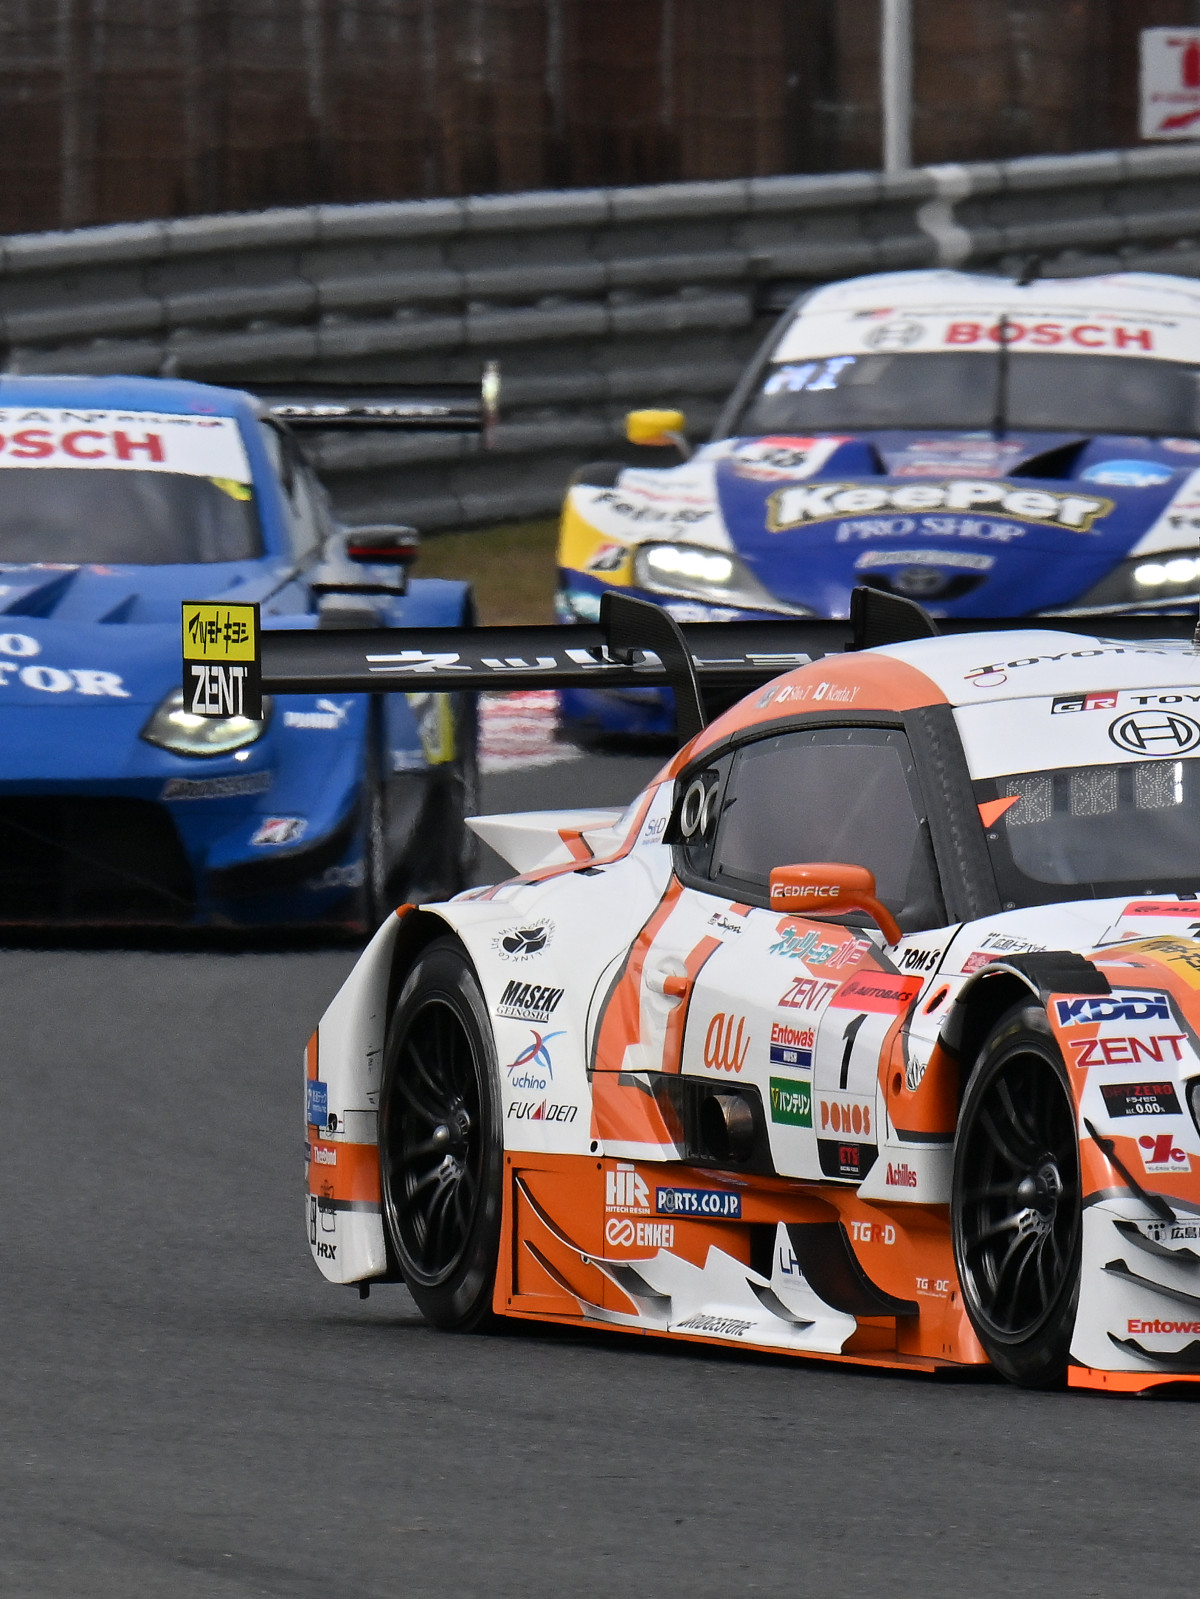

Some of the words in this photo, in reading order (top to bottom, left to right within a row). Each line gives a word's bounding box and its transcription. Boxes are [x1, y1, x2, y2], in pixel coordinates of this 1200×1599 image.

[944, 322, 1153, 352] BOSCH
[0, 429, 165, 463] SCH
[777, 480, 1100, 524] KeePer
[836, 517, 914, 543] PRO
[921, 517, 1025, 542] SHOP
[191, 665, 248, 715] ZENT
[1052, 692, 1118, 714] GR
[784, 885, 841, 897] EDIFICE
[897, 948, 940, 972] TOM'S
[499, 980, 565, 1012] MASEKI
[777, 976, 839, 1011] ZENT
[1057, 996, 1171, 1025] KDDI
[703, 1012, 751, 1073] au
[770, 1022, 815, 1048] Entowa's
[839, 1013, 868, 1090] 1
[1071, 1034, 1187, 1068] ZENT
[512, 1072, 546, 1090] uchino
[1134, 1084, 1173, 1096] ZERO
[507, 1099, 578, 1123] FUKADEN
[780, 1091, 810, 1115] バンテリン
[820, 1100, 871, 1136] PONOS
[886, 1162, 917, 1187] Achilles
[605, 1206, 627, 1214] HITECH
[628, 1207, 650, 1215] RESIN
[636, 1223, 674, 1247] ENKEI
[317, 1242, 337, 1260] HRX
